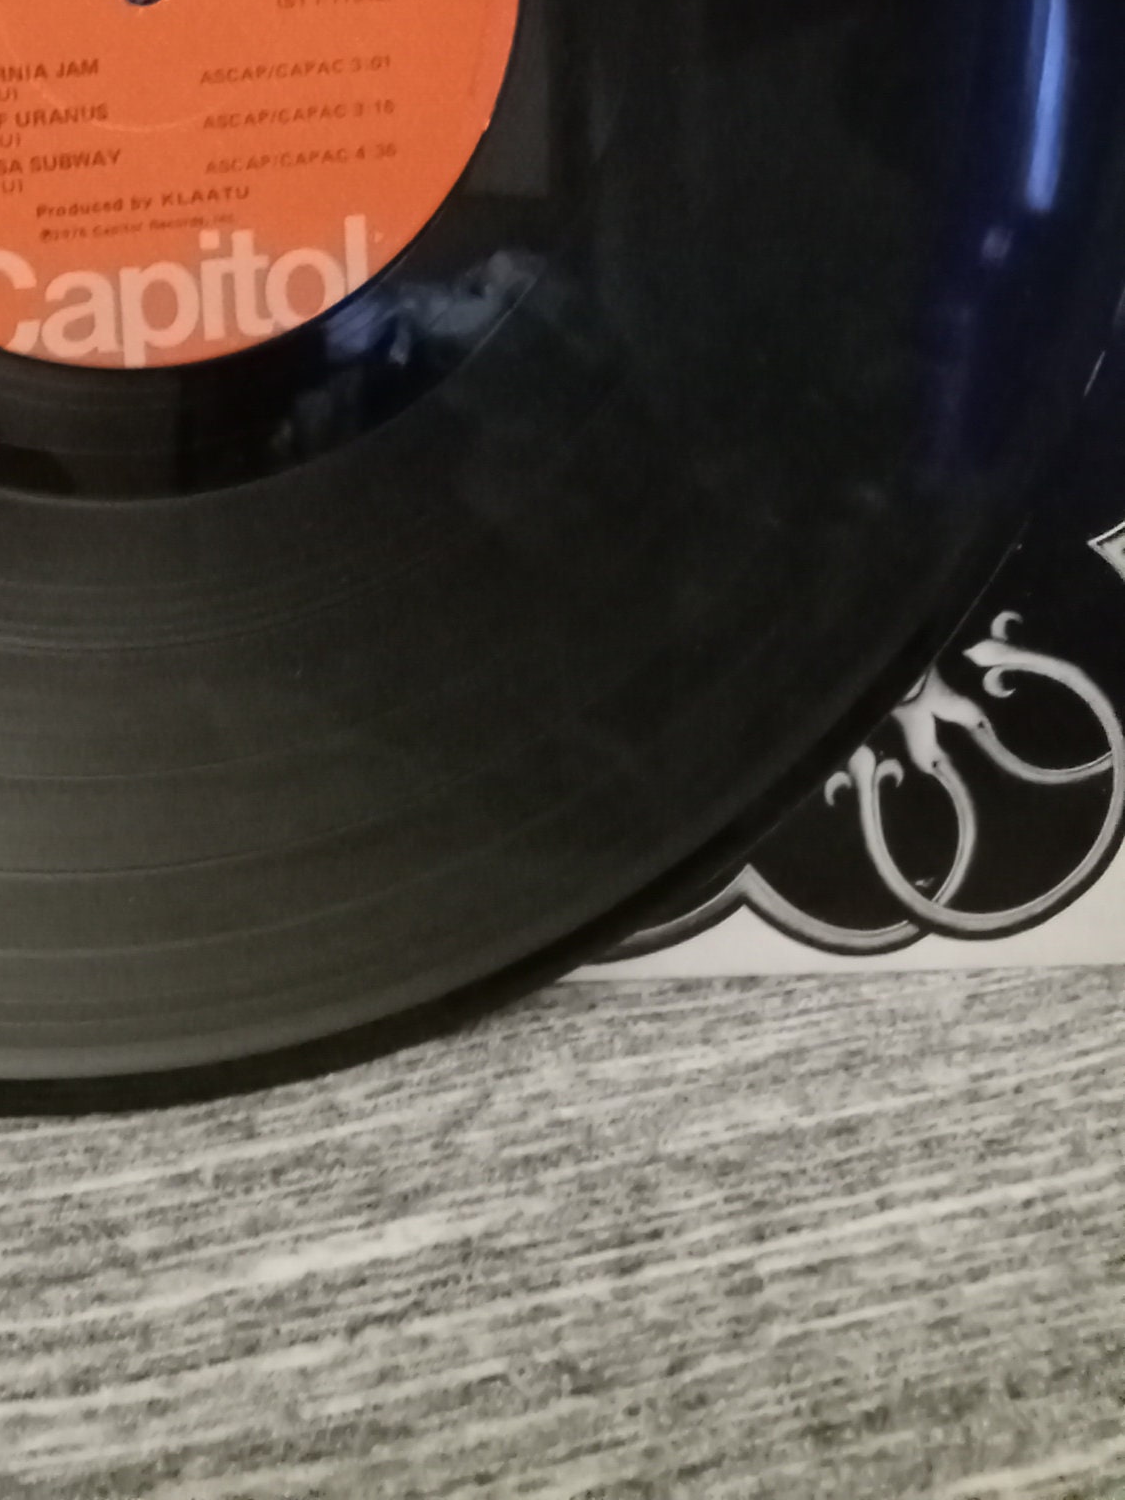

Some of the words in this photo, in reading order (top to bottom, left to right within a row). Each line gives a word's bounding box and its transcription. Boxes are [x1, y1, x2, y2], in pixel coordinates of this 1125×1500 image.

[56, 58, 100, 79] JAM
[15, 102, 109, 128] URANUS
[29, 148, 122, 174] SUBWAY
[36, 197, 124, 219] Produced
[130, 195, 153, 211] by
[160, 186, 250, 207] KLAATU
